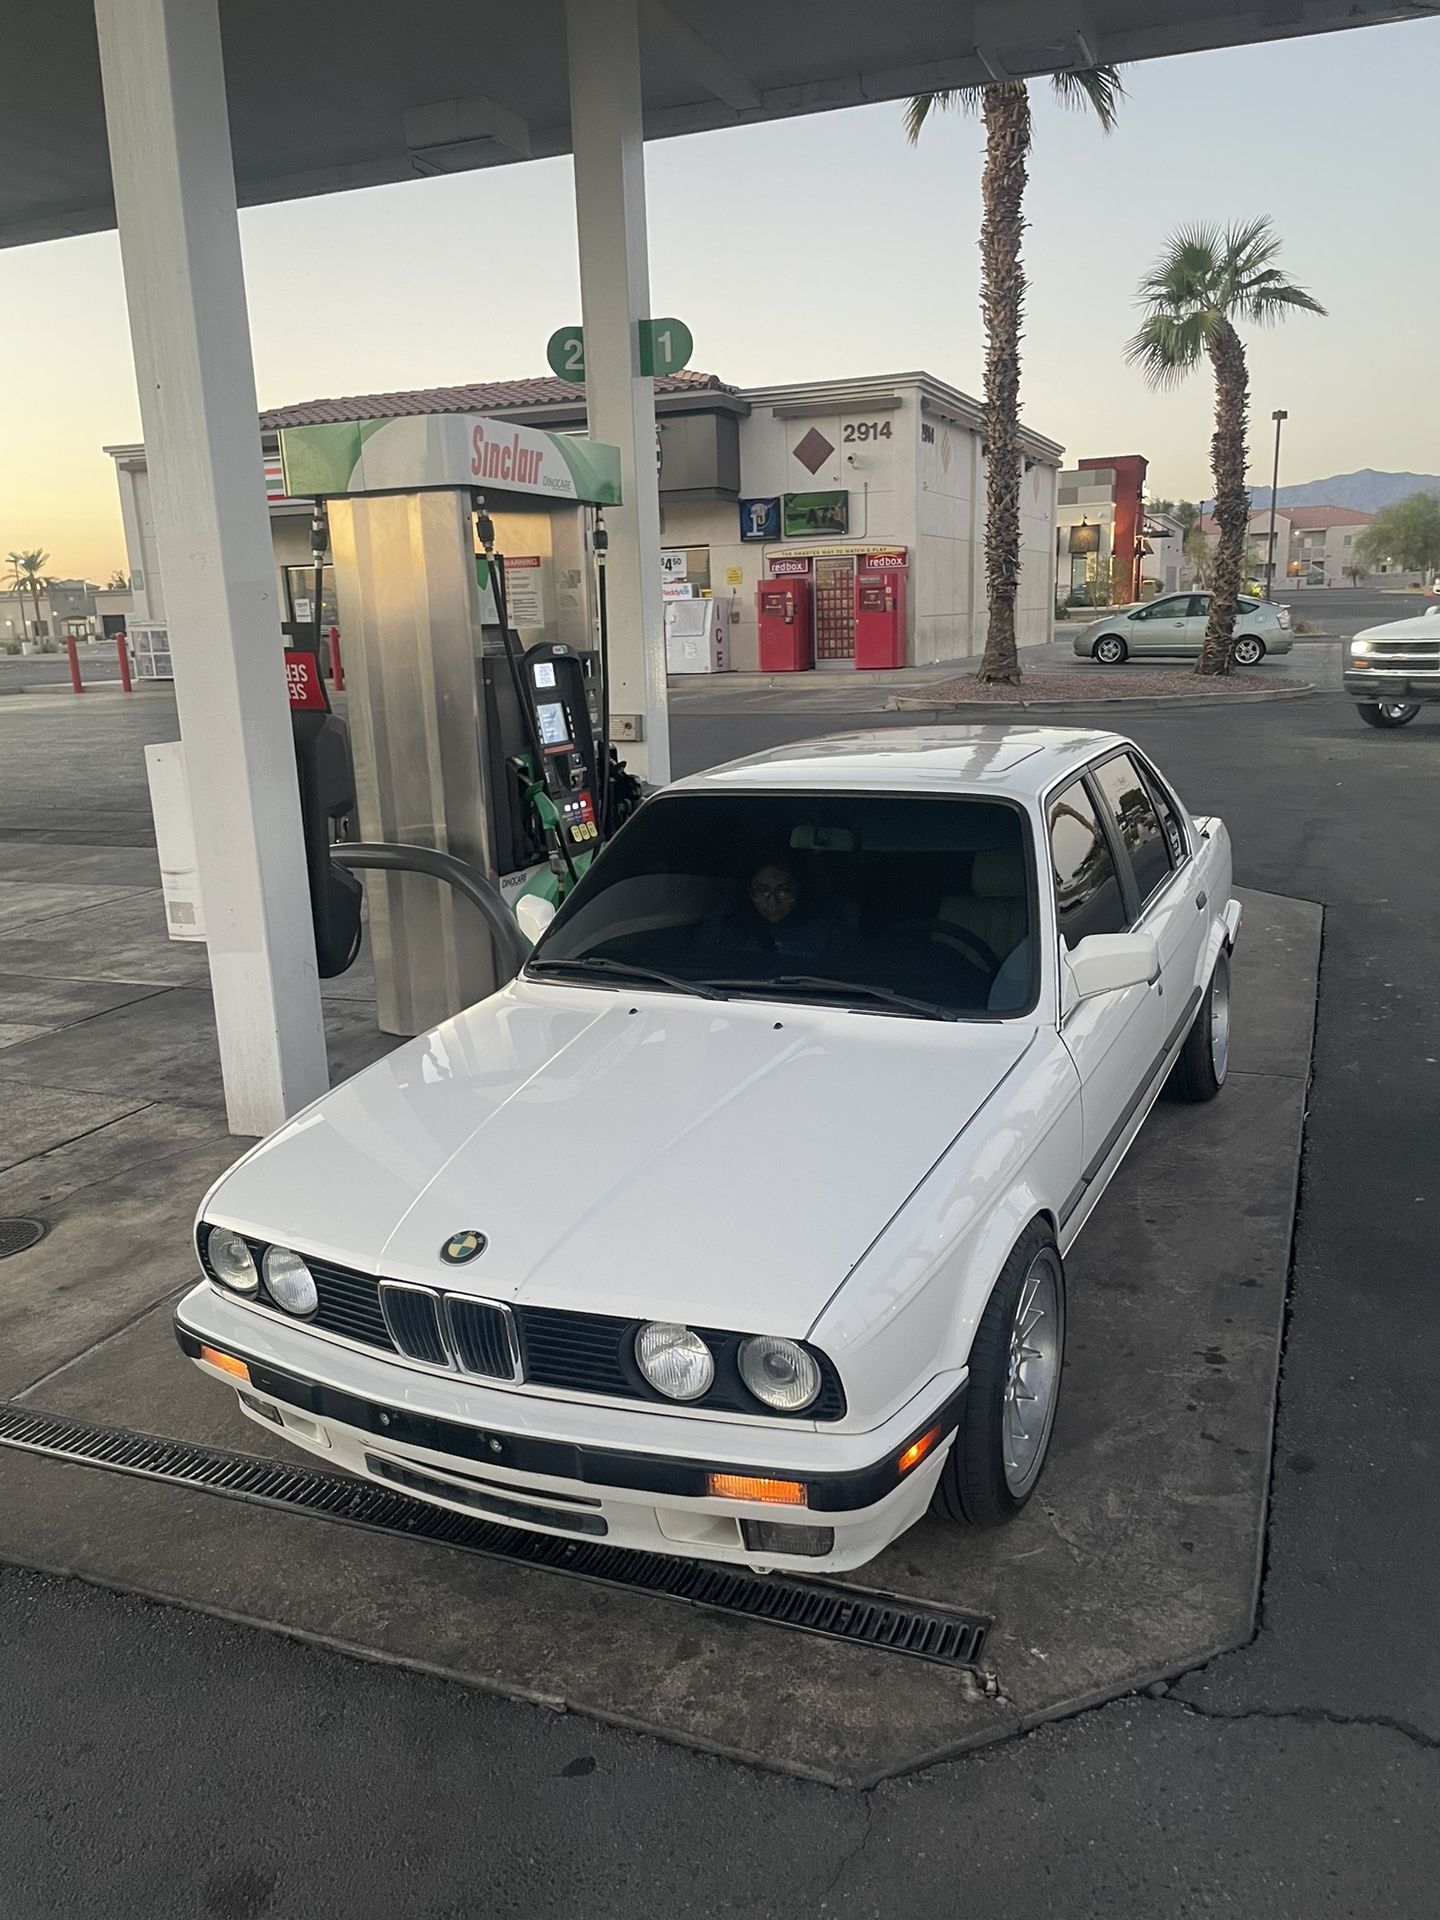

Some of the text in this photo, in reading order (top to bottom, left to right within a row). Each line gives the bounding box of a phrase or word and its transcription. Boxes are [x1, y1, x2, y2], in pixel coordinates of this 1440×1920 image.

[564, 339, 584, 370] 2
[658, 331, 672, 363] 1
[843, 421, 893, 443] 2914
[471, 424, 544, 485] Sinclair
[543, 475, 571, 490] DINOCARE
[771, 561, 803, 572] redbox
[869, 556, 904, 567] redbox
[715, 604, 724, 668] ICE
[585, 658, 592, 678] 1
[501, 872, 527, 889] DINOCARE
